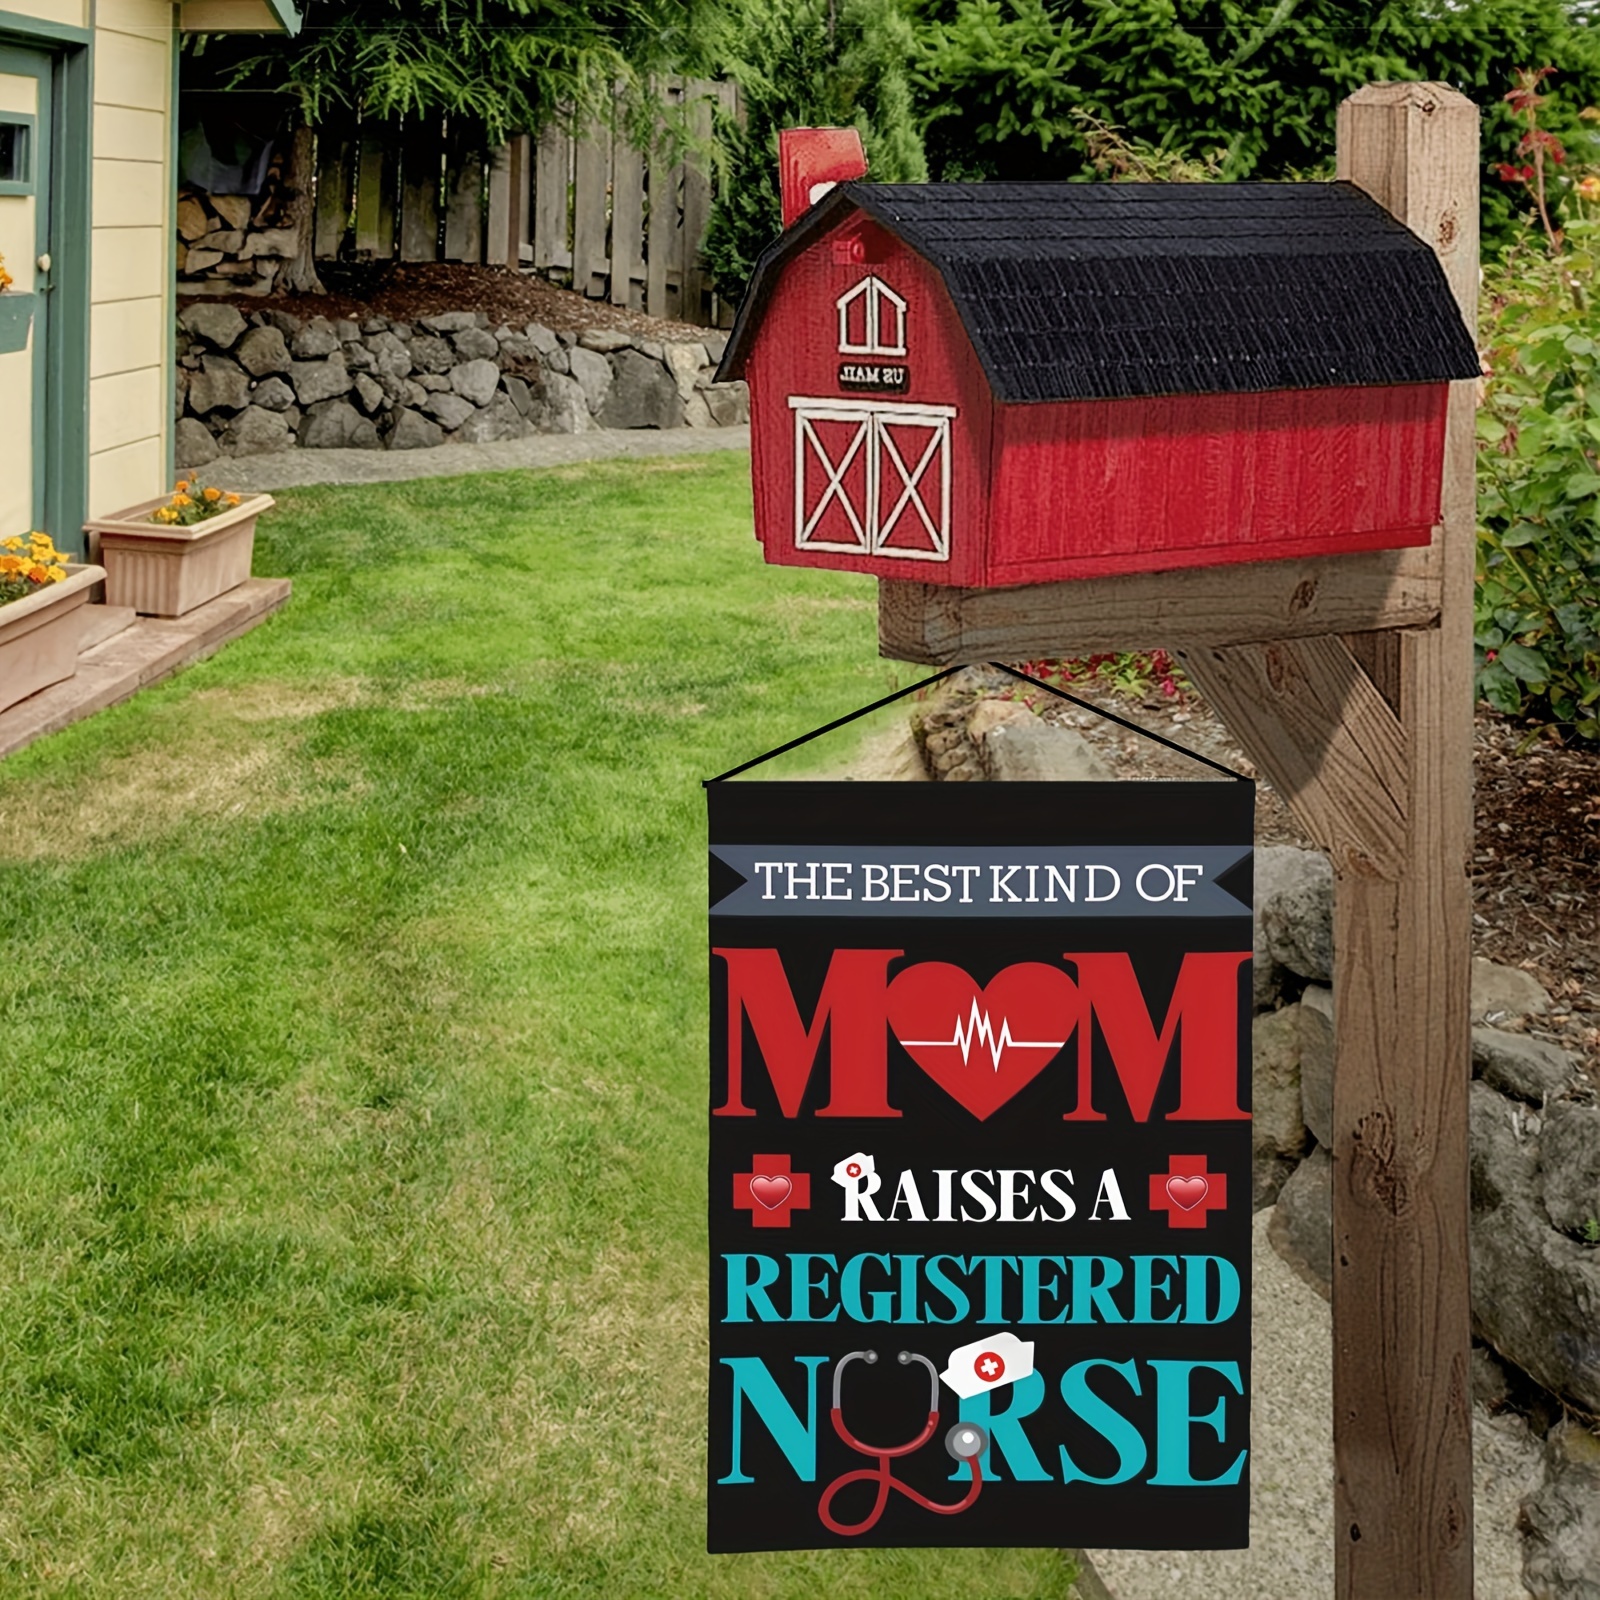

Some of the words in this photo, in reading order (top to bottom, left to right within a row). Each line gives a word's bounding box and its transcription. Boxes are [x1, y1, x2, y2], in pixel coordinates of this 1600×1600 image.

[754, 862, 853, 901] THE
[861, 864, 981, 903] BEST
[988, 865, 1121, 903] KIND
[1135, 863, 1204, 902] OF
[840, 1166, 1077, 1223] RAISES
[1088, 1167, 1132, 1222] A
[720, 1252, 1241, 1325] REGISTERED
